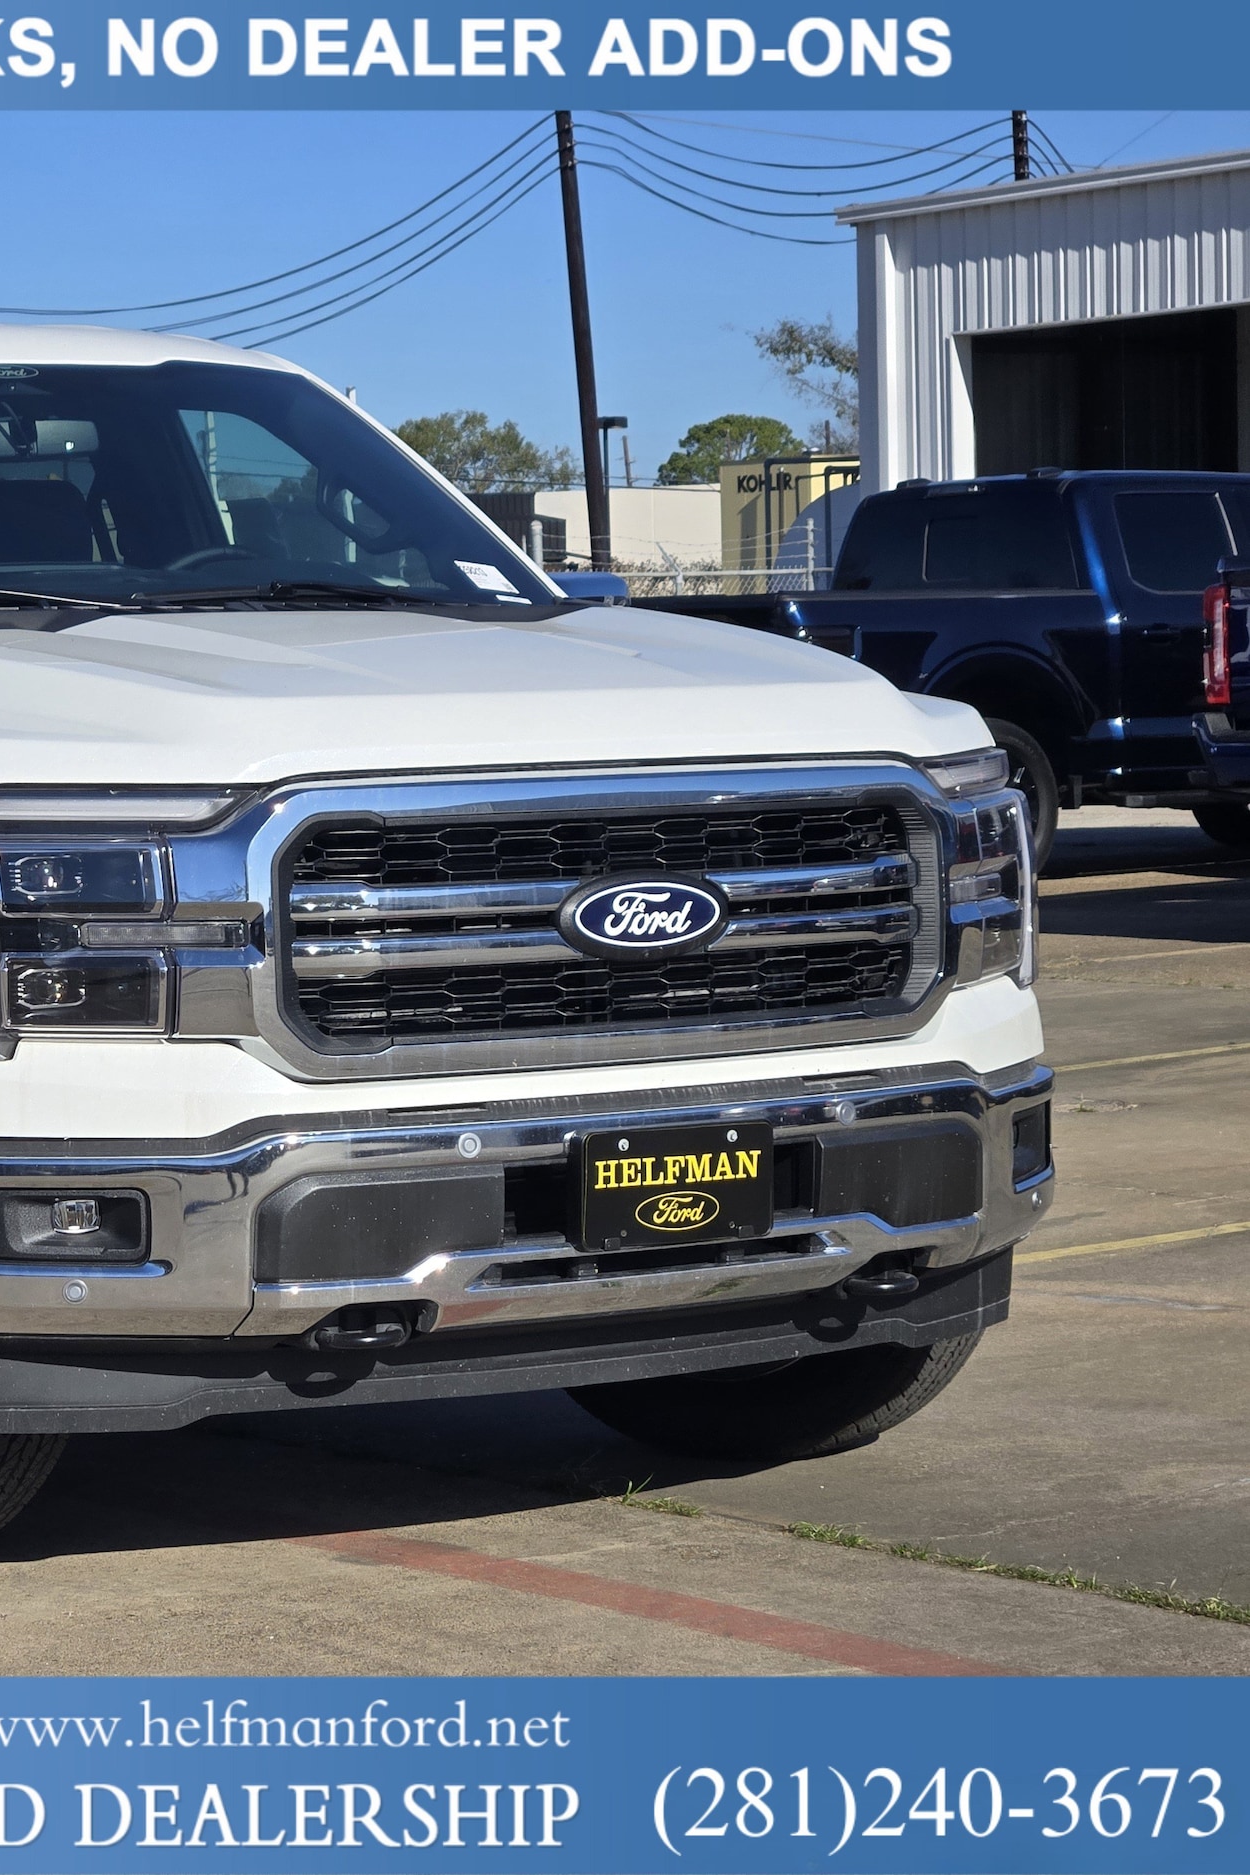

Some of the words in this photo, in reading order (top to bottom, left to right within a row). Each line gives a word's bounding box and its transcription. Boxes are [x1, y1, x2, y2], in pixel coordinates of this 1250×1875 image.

[737, 472, 792, 493] KOHLR
[603, 891, 694, 937] Ford
[594, 1149, 762, 1190] HELFMAN
[652, 1196, 705, 1225] Ford
